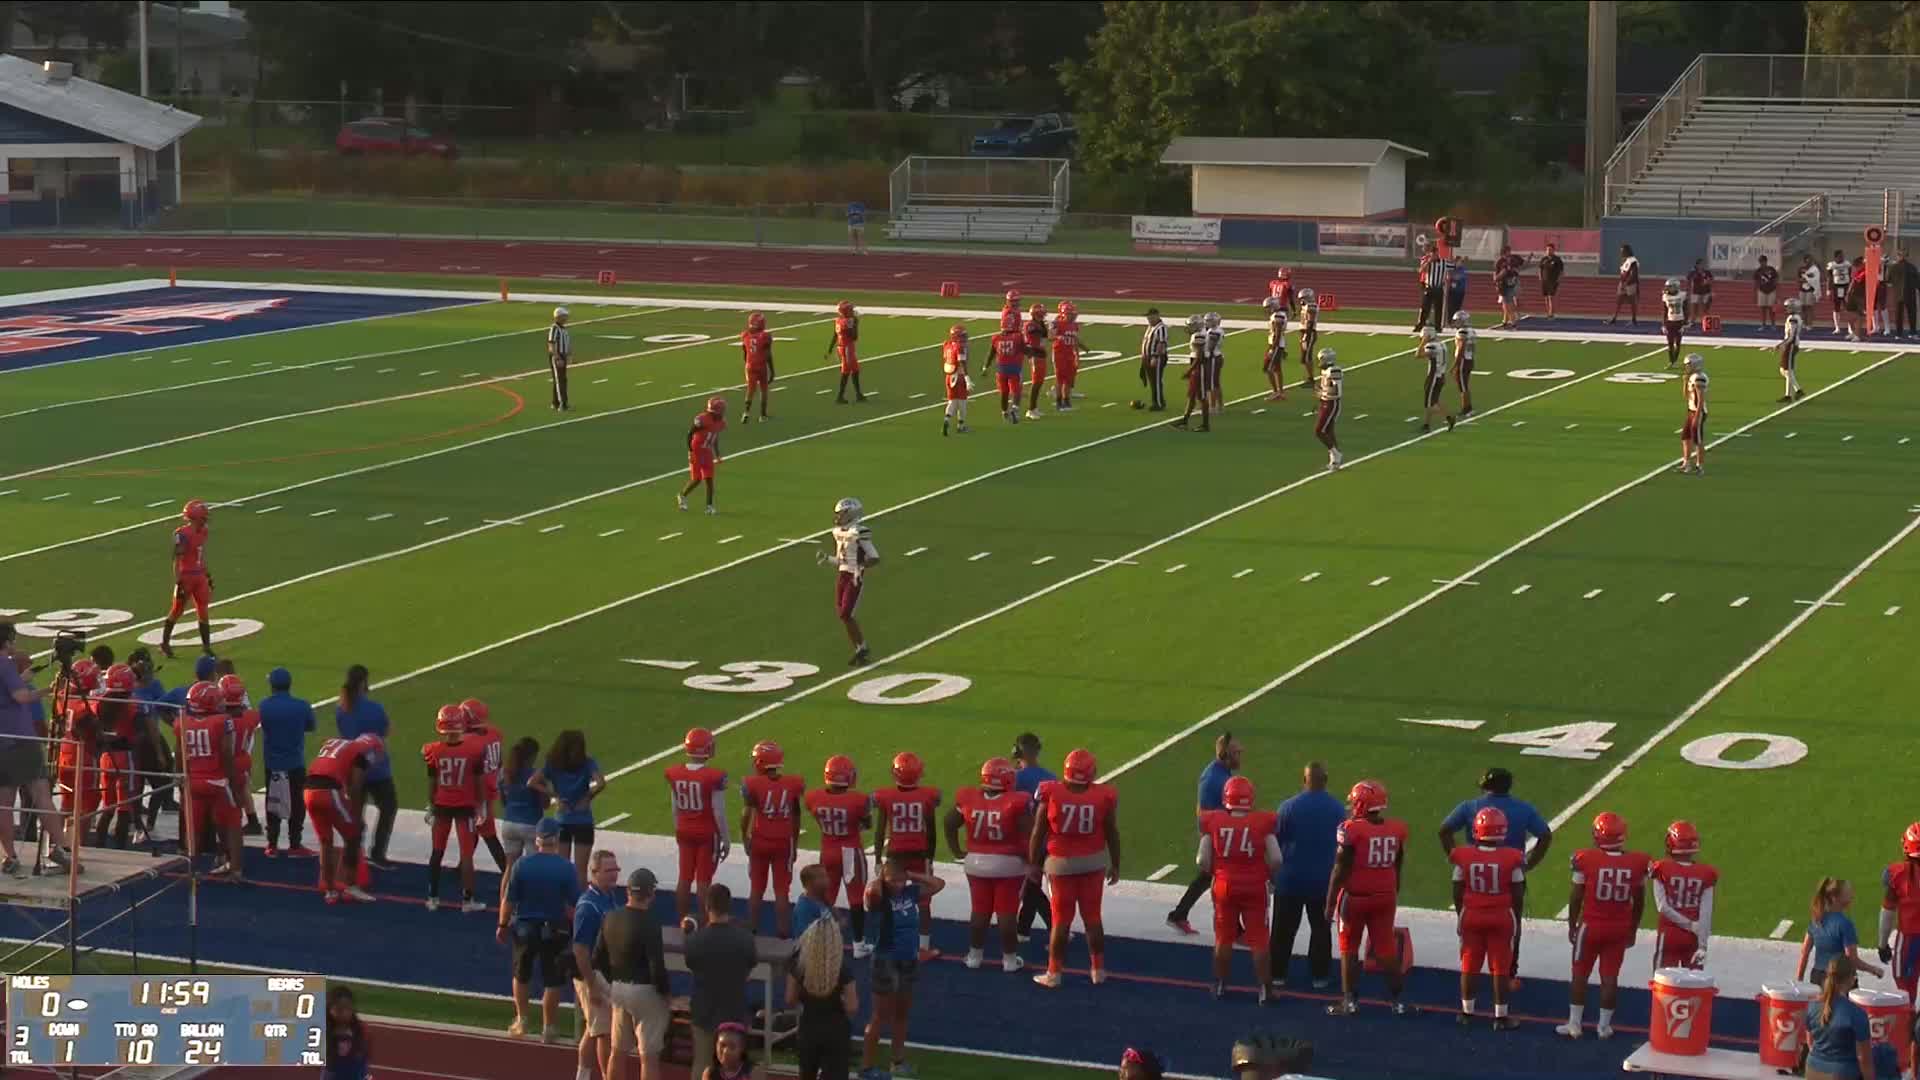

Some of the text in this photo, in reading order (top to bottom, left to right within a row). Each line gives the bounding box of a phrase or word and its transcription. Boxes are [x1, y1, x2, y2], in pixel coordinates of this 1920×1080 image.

[1705, 316, 1720, 331] 30
[439, 757, 466, 785] 27
[674, 780, 702, 811] 60
[763, 790, 792, 818] 44
[815, 807, 849, 836] 22
[891, 802, 924, 833] 29
[971, 809, 1004, 841] 75
[1060, 803, 1095, 834] 78
[1219, 827, 1255, 858] 74
[1367, 836, 1397, 868] 66
[1469, 863, 1500, 894] 61
[1595, 868, 1632, 902] 65
[1670, 999, 1691, 1019] G
